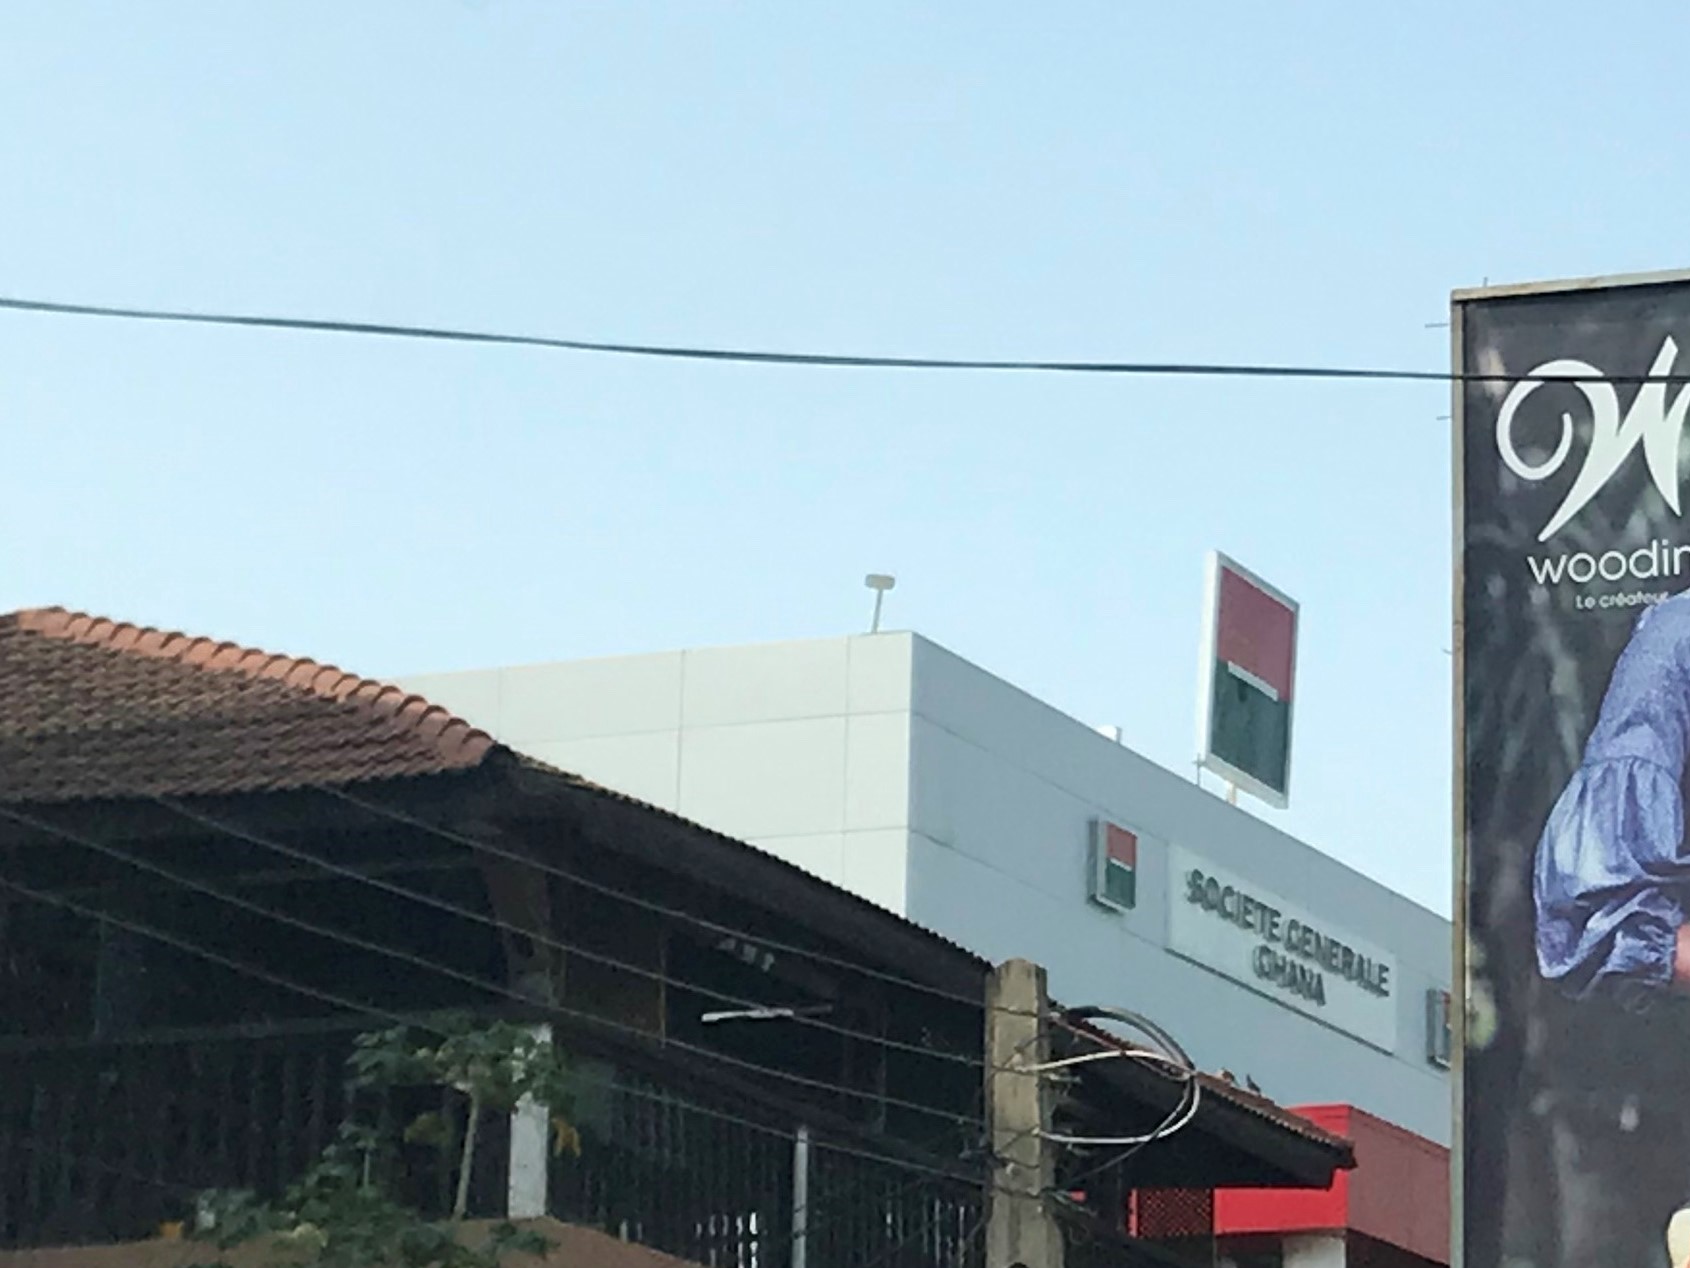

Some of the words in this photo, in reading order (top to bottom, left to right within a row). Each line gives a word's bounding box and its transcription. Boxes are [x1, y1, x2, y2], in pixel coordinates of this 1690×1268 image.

[1576, 593, 1596, 609] Le
[1187, 868, 1282, 943] SOCIETE
[1284, 919, 1391, 998] GENERALE
